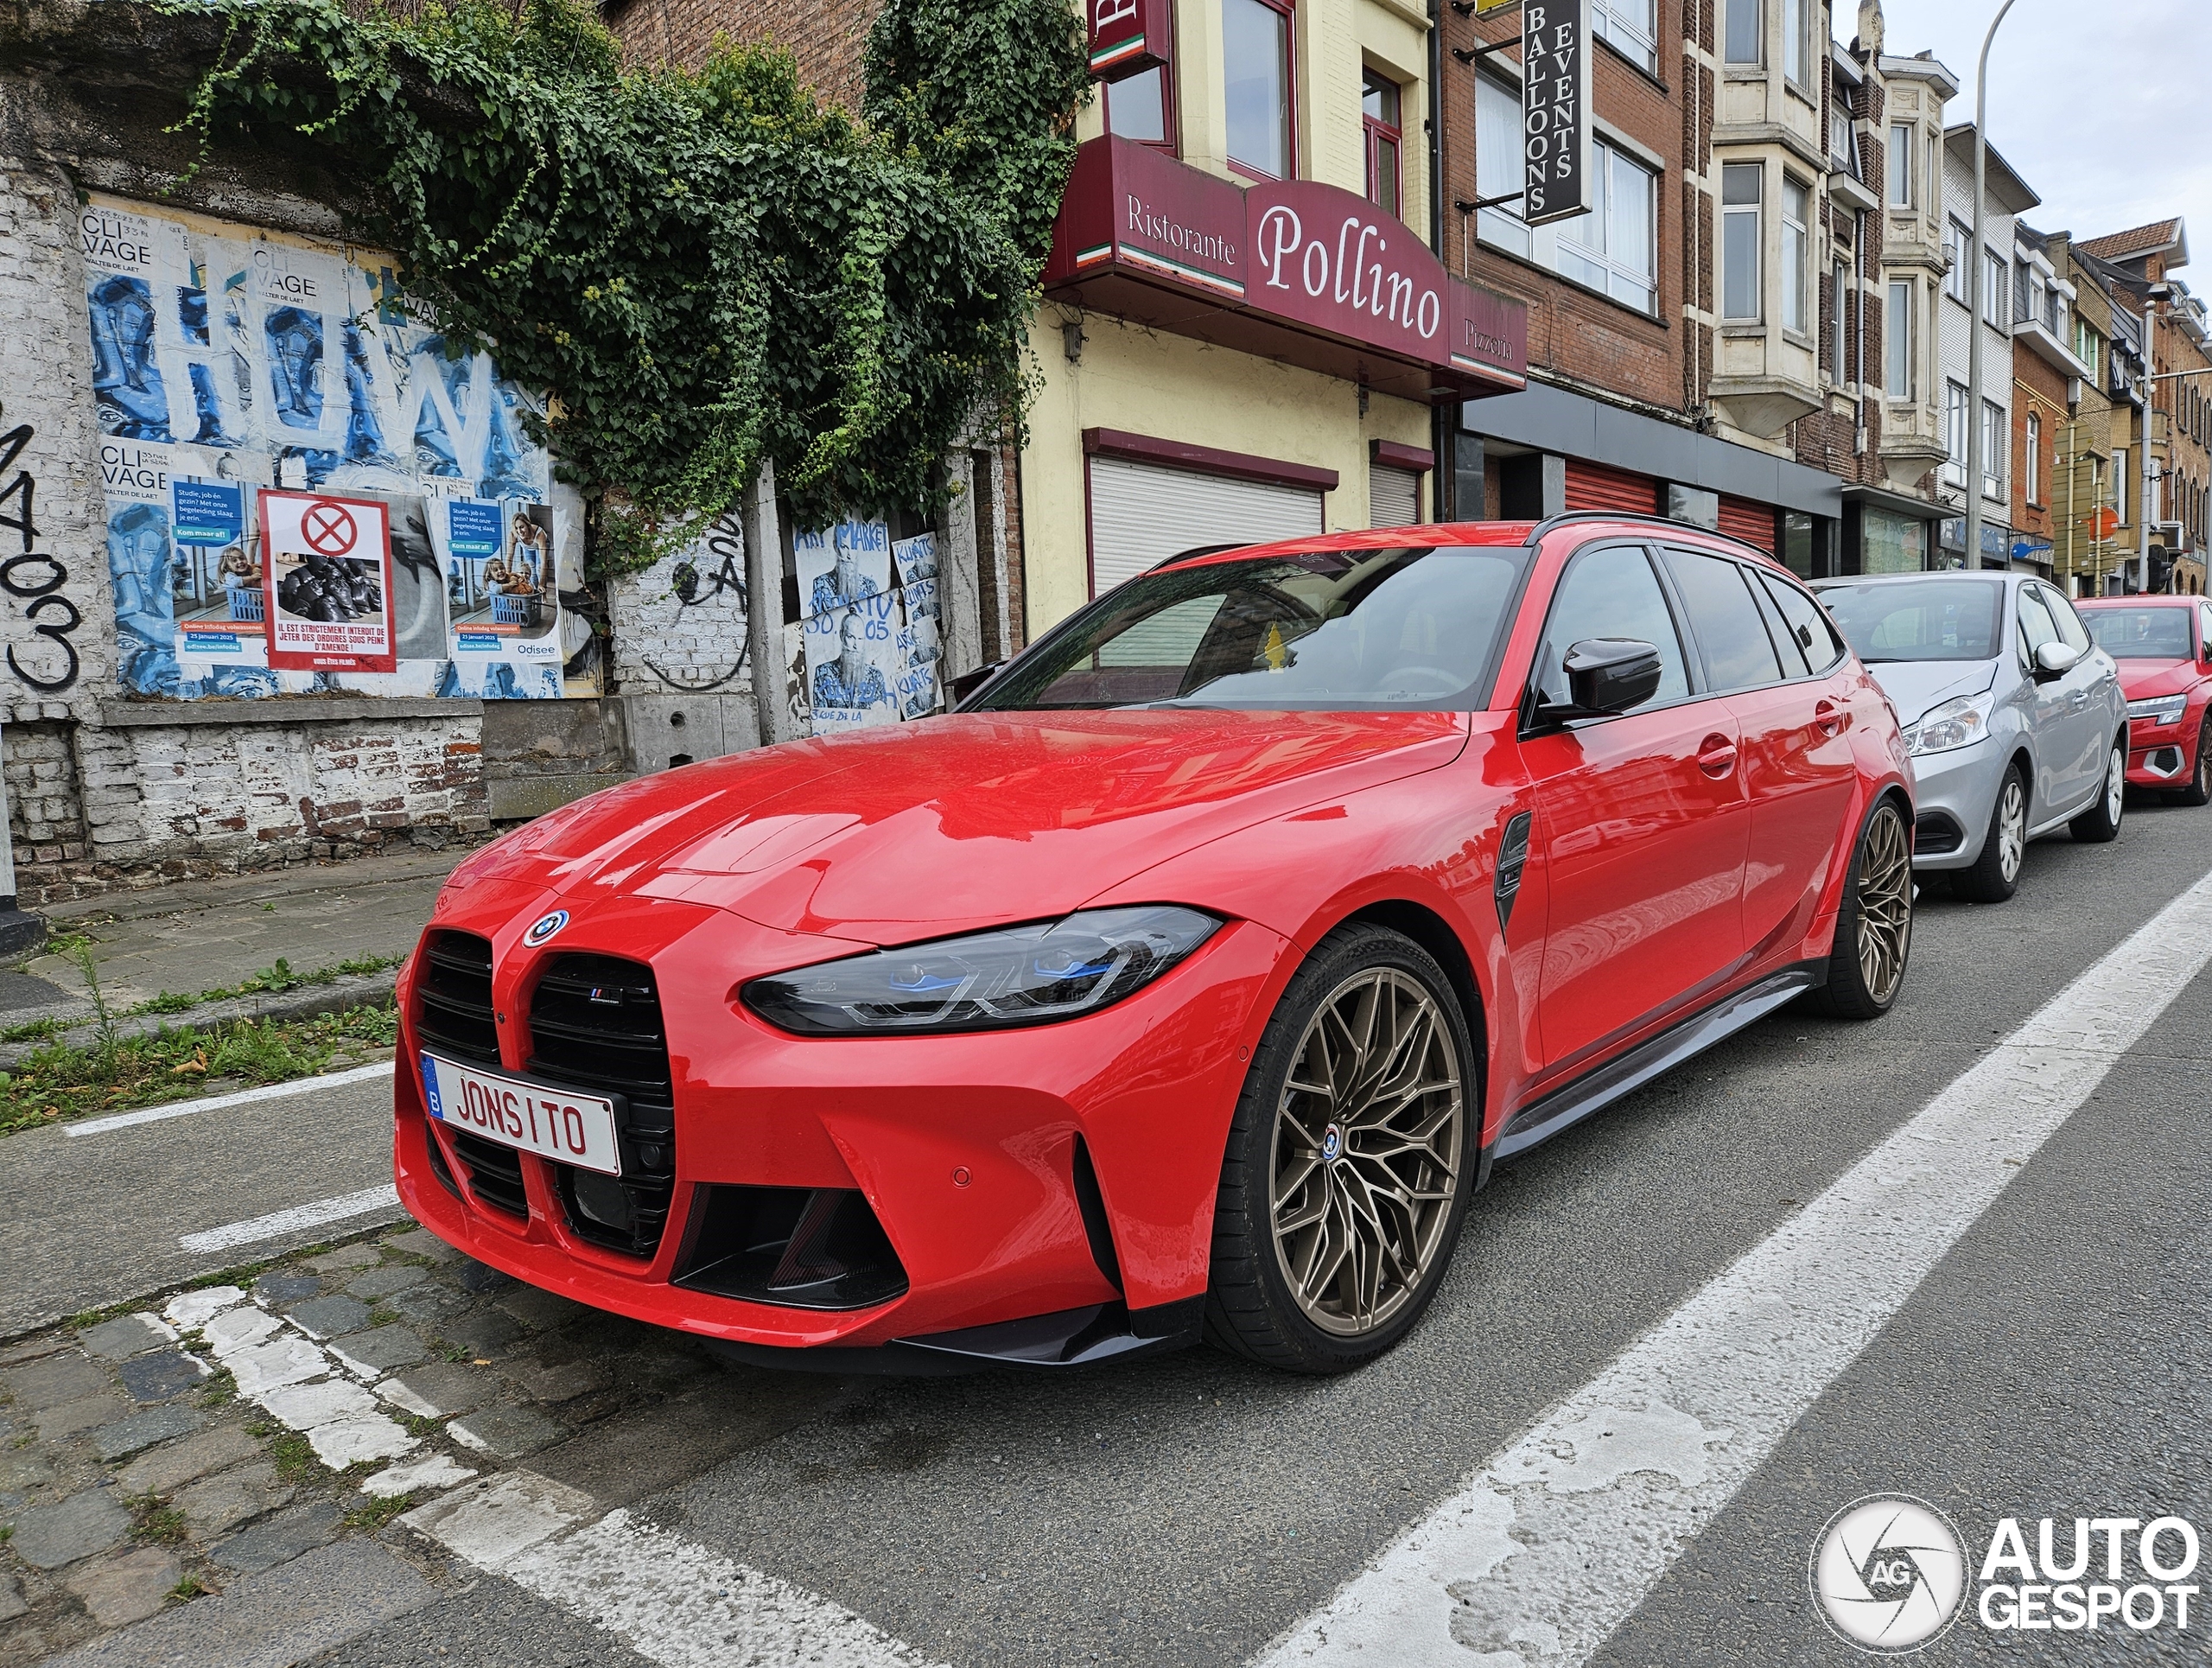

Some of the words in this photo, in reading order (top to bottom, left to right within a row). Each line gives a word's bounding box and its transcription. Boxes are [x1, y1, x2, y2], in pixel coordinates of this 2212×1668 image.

[1526, 6, 1548, 212] BALLOONS
[1553, 22, 1575, 180] EVENTS
[82, 214, 122, 239] CLI
[1127, 193, 1236, 265] Ristorante
[83, 233, 151, 265] VAGE
[84, 257, 111, 268] WALTER
[123, 264, 140, 273] LAET
[1257, 205, 1440, 339] Pollino
[255, 269, 317, 297] VAGE
[1465, 318, 1514, 360] Pizzeria
[101, 445, 141, 468] CLI
[101, 465, 167, 490] VAGE
[102, 487, 130, 497] WALTER
[178, 489, 201, 498] Studie,
[179, 506, 217, 517] begeleiding
[452, 507, 470, 516] Studie,
[453, 523, 482, 532] begeleiding
[836, 520, 887, 551] MARKET
[278, 623, 284, 633] IL
[287, 624, 298, 633] EST
[301, 625, 346, 634] STRICTEMENT
[347, 627, 374, 635] INTERDIT
[377, 627, 385, 636] DE
[279, 633, 300, 641] JETER
[302, 633, 315, 642] DES
[317, 634, 347, 643] ORDURES
[349, 635, 365, 644] SOUS
[367, 636, 385, 645] PEINE
[315, 643, 349, 652] D'AMENDE
[518, 645, 556, 654] Odisee
[429, 1091, 440, 1112] B
[456, 1076, 587, 1156] JONSITO
